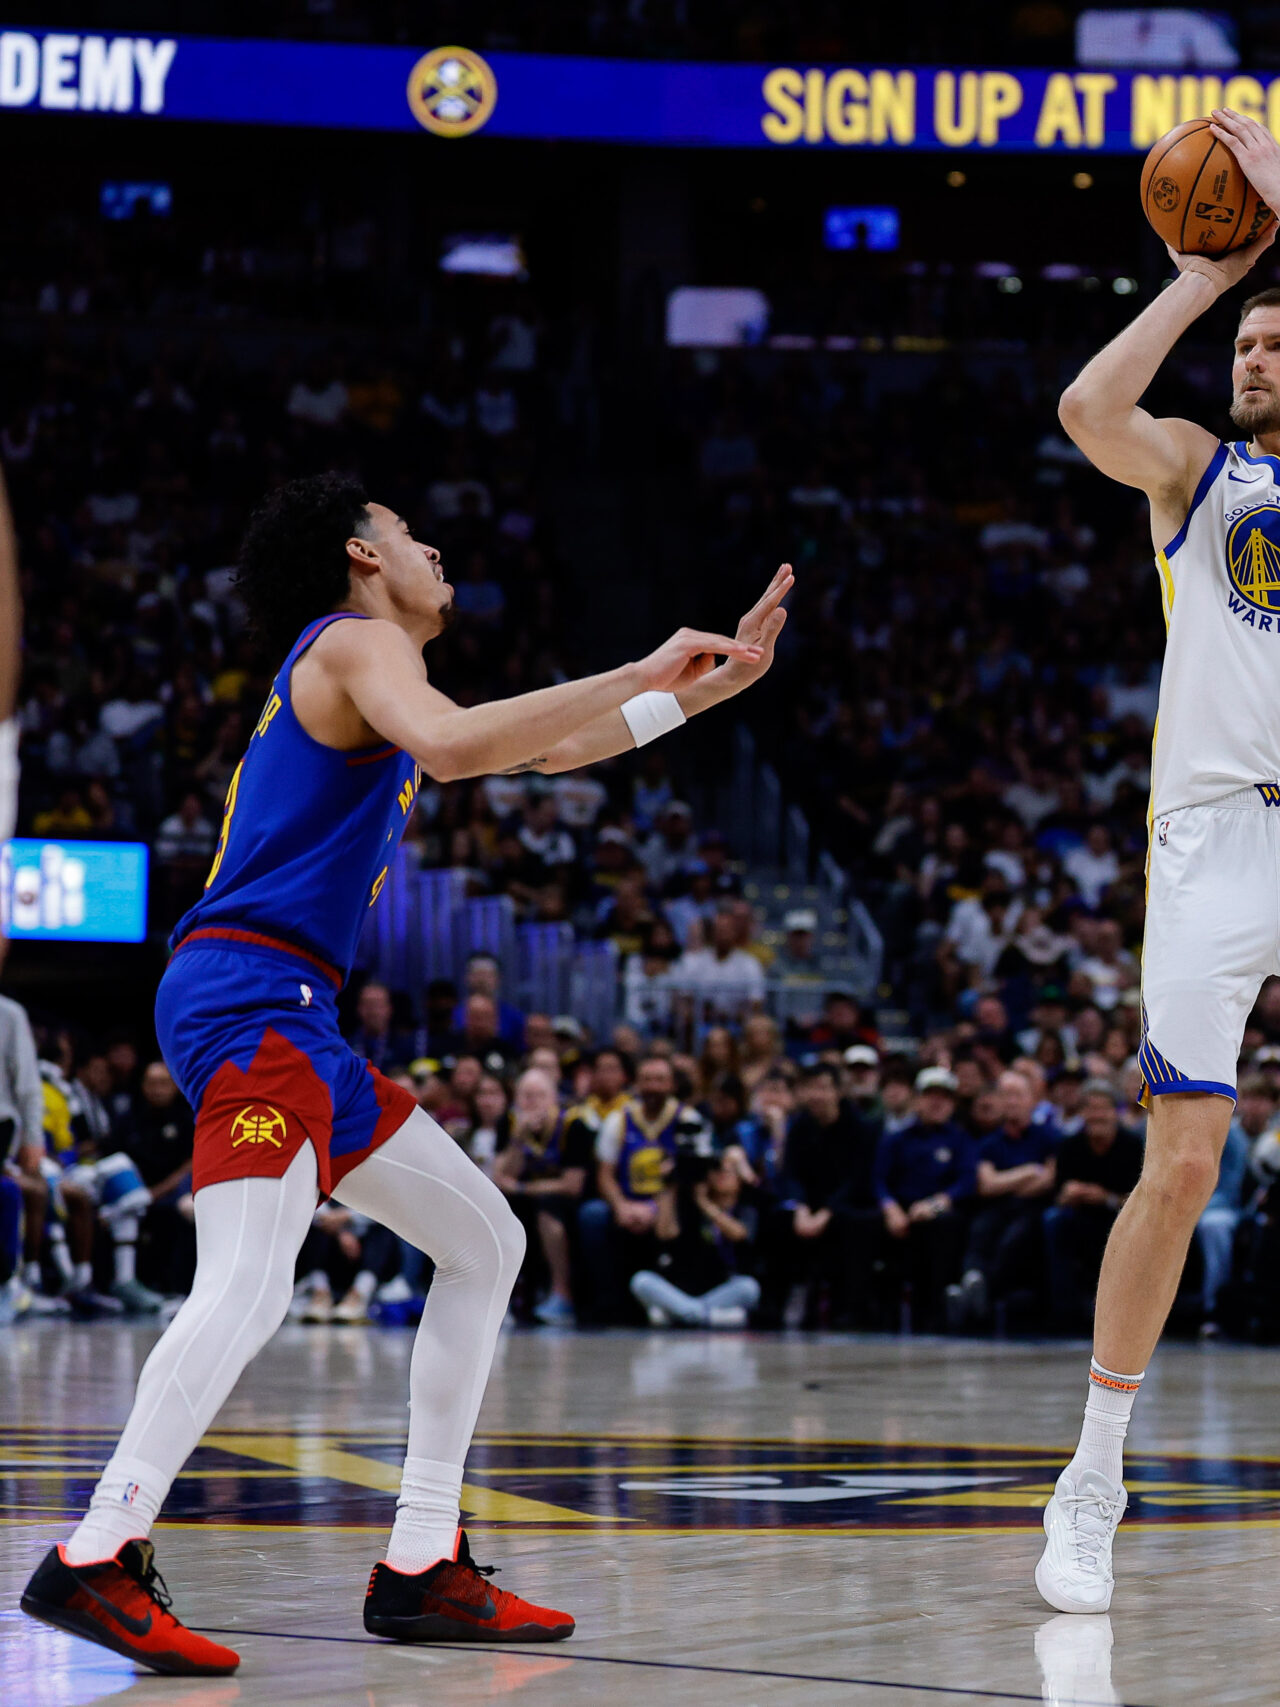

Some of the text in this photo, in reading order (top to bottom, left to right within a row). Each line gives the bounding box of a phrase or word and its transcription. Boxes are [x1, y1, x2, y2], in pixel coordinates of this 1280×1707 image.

[0, 32, 178, 114] DEMY
[762, 68, 915, 144] SIGN
[935, 71, 1024, 147] UP
[1035, 73, 1117, 148] AT
